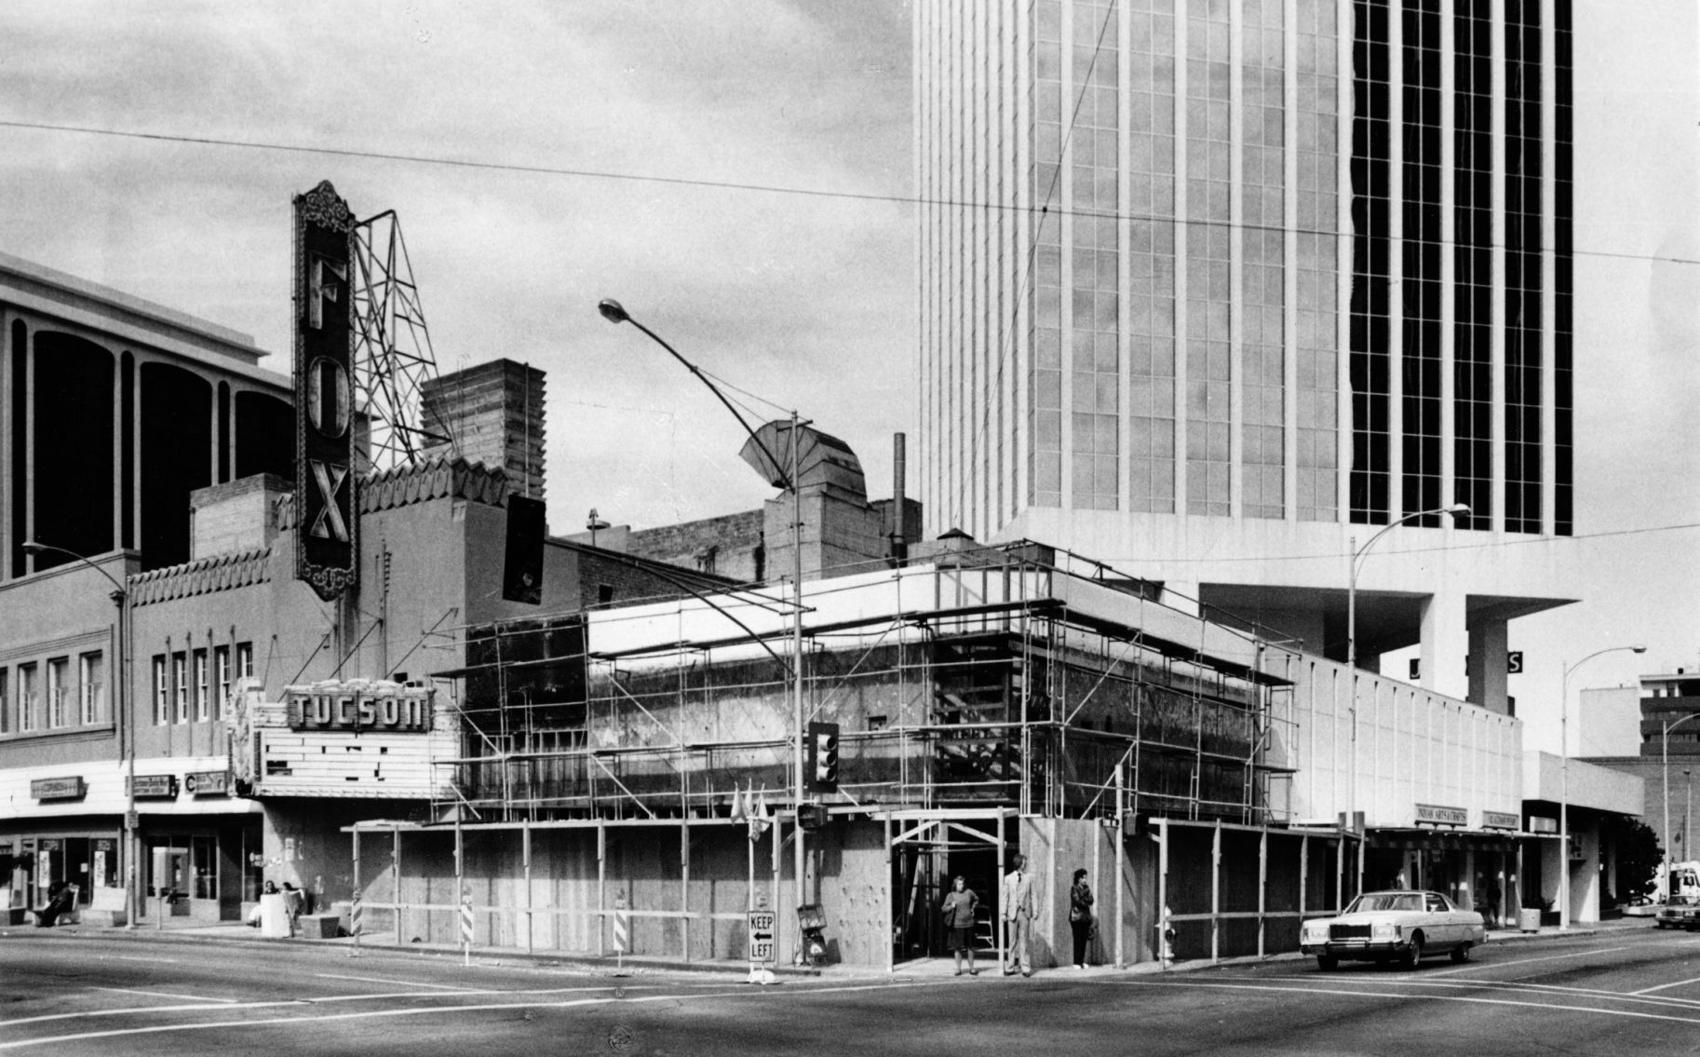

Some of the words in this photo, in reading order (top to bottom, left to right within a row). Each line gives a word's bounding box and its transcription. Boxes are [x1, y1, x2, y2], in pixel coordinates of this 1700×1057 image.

[308, 253, 350, 543] FOX
[294, 695, 422, 726] TUCSON
[750, 916, 773, 930] KEEP
[751, 943, 773, 958] LEFT
